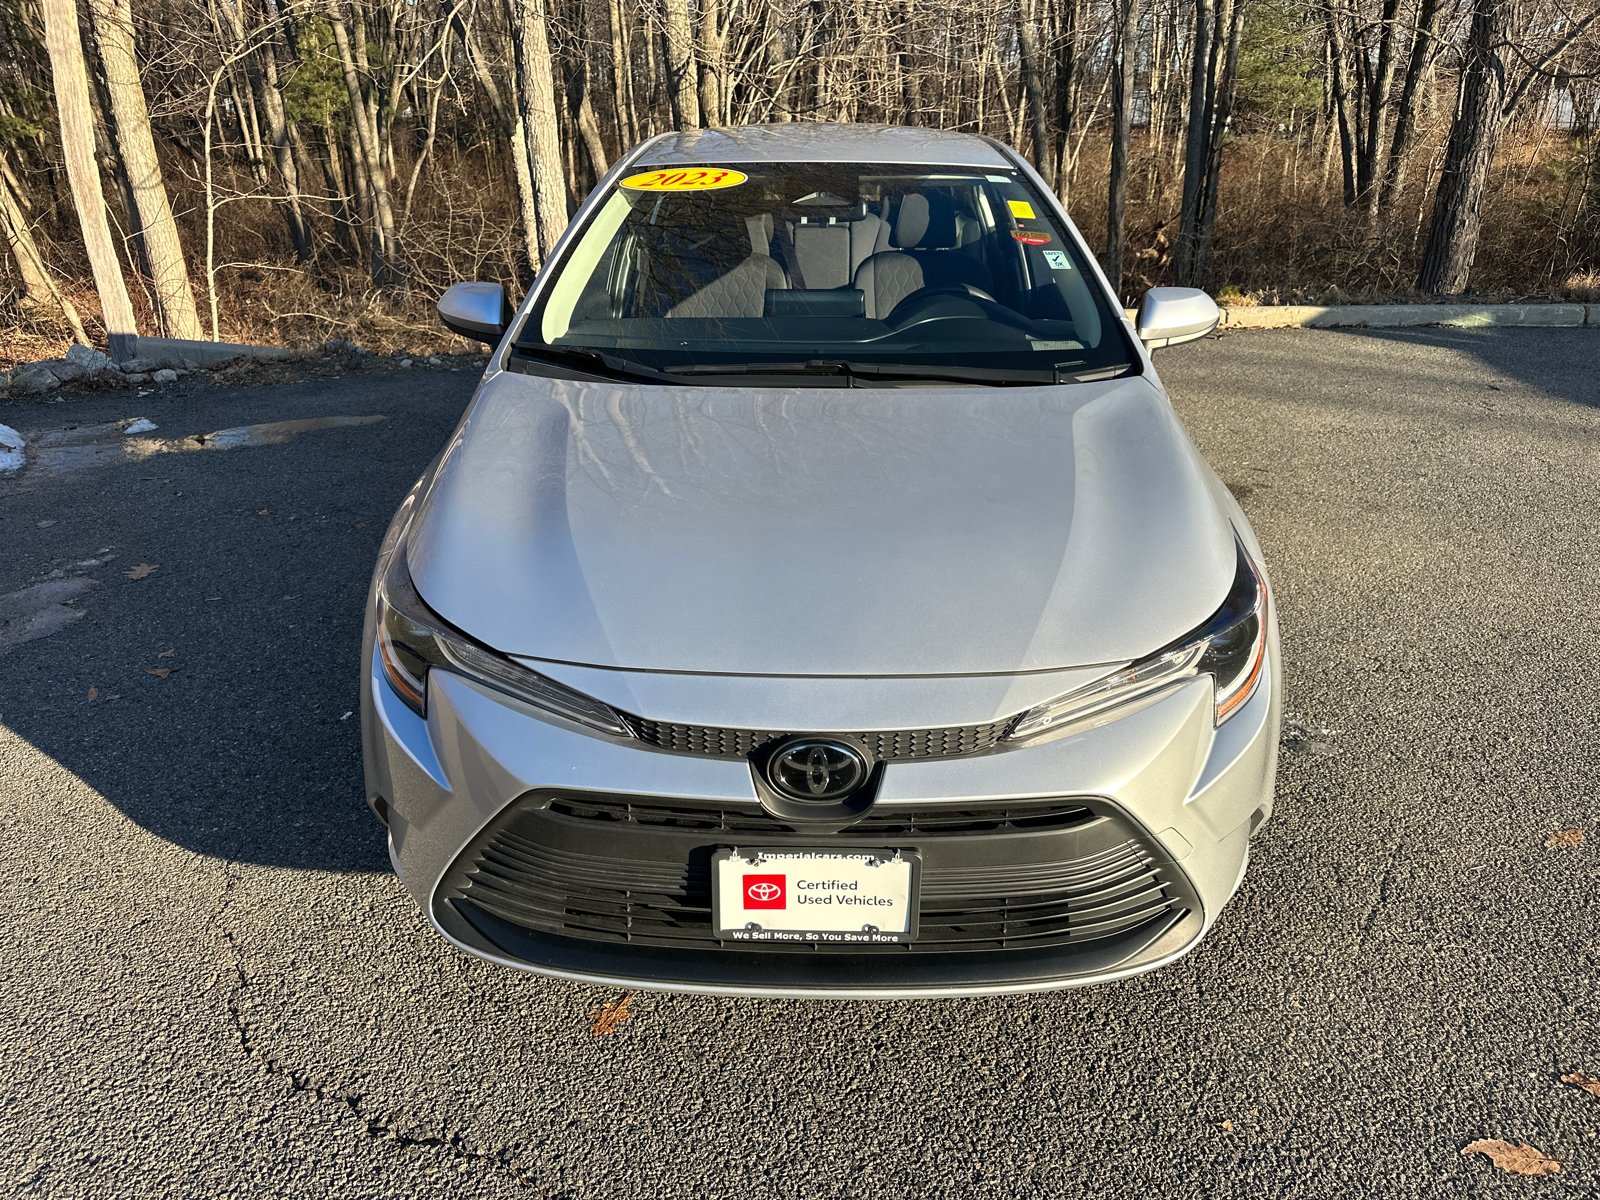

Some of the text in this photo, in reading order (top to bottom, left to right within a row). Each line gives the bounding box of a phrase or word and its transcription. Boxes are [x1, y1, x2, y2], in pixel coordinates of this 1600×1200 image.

[638, 172, 728, 187] 2023
[757, 852, 875, 861] Imperialcars.com
[797, 880, 858, 891] Certified
[797, 894, 893, 907] Used Vehicles
[732, 931, 899, 942] We Sell More, So You Save More
